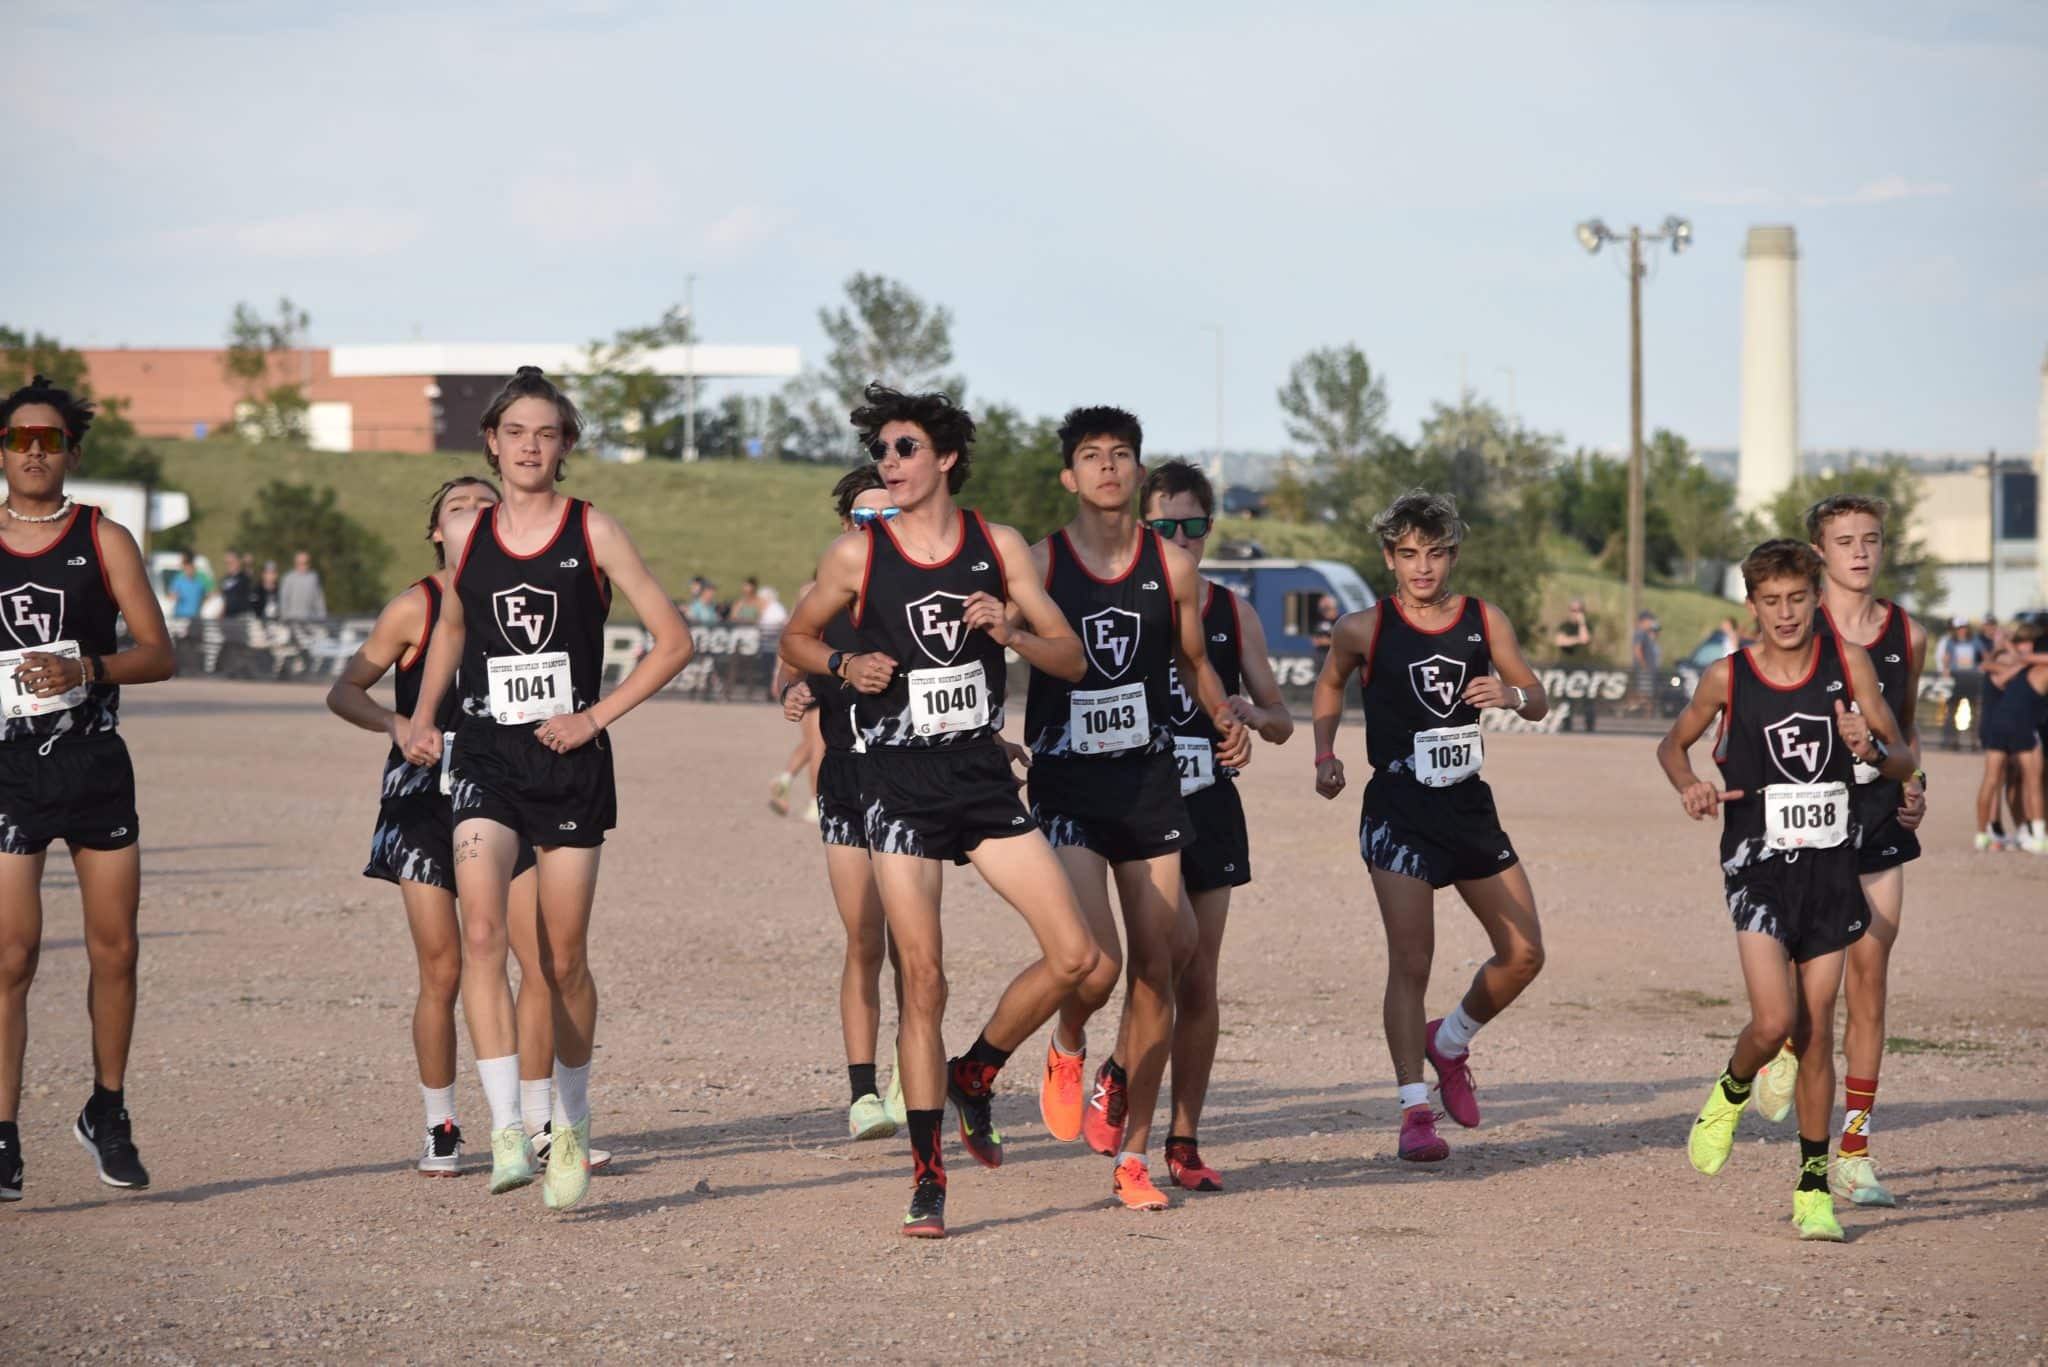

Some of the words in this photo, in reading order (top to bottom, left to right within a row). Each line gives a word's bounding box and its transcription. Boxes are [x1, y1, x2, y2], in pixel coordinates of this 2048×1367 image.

[11, 595, 51, 643] EV
[505, 597, 544, 645] EV
[920, 604, 960, 651] EV
[1095, 619, 1129, 666] EV
[504, 674, 556, 703] 1041
[923, 684, 976, 715] 1040
[1420, 666, 1455, 706] EV
[1082, 705, 1136, 735] 1043
[1177, 755, 1199, 778] 21
[1428, 744, 1472, 769] 1037
[1778, 726, 1820, 772] EV
[1779, 802, 1836, 829] 1038
